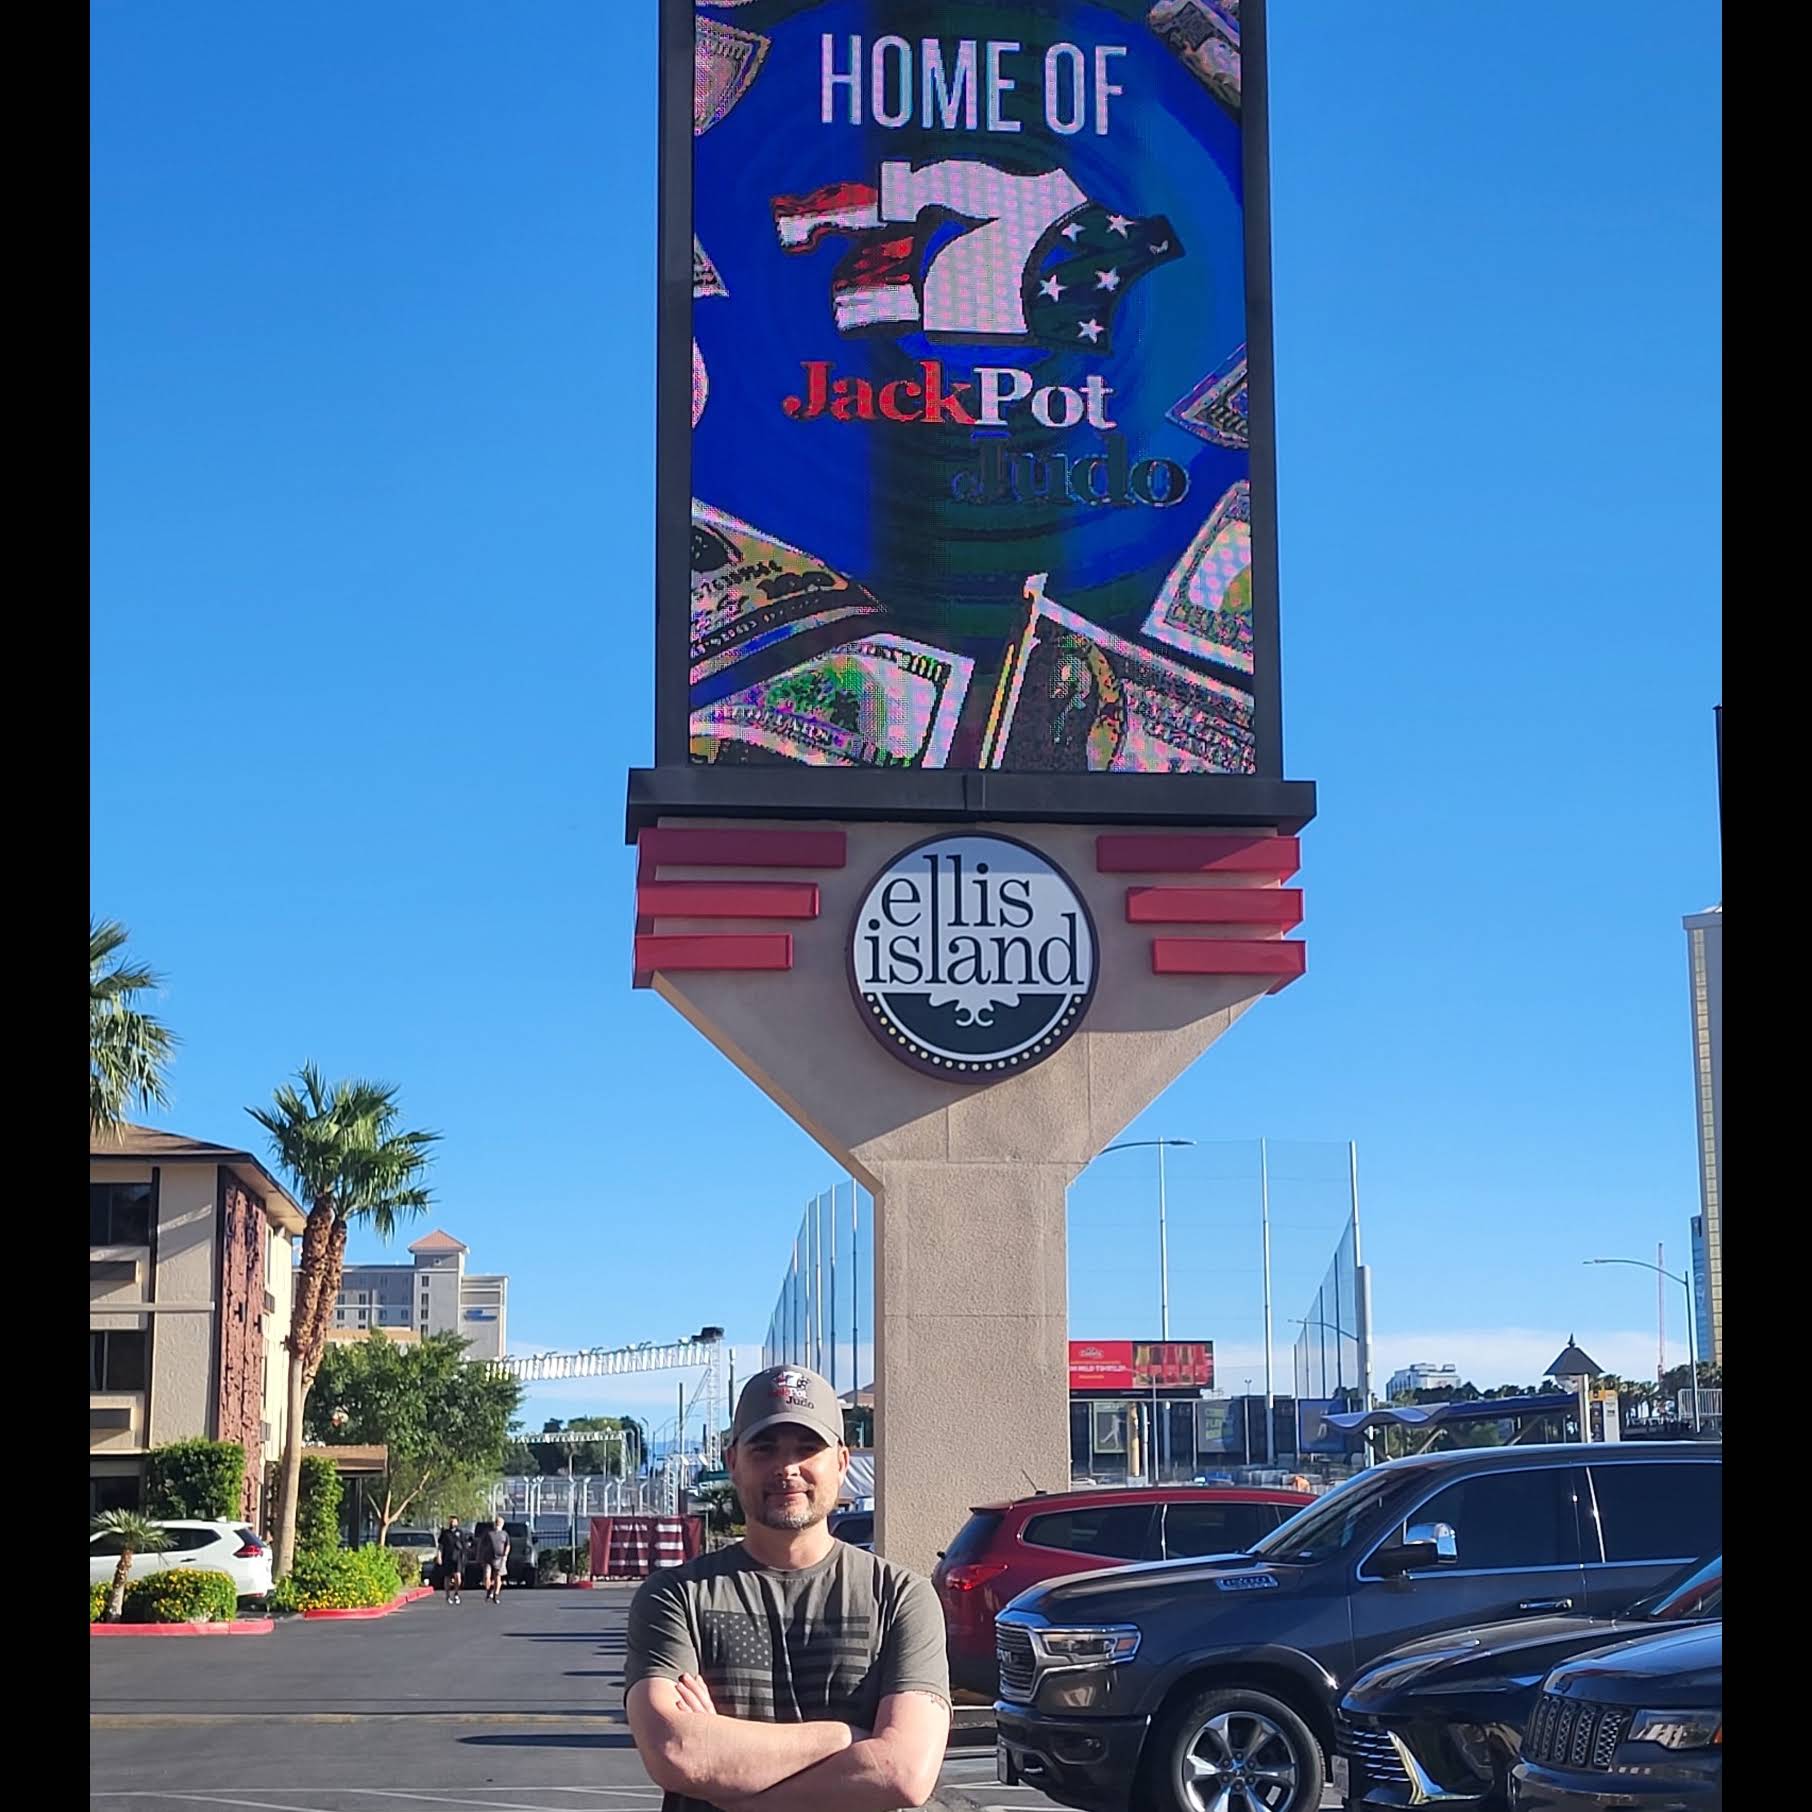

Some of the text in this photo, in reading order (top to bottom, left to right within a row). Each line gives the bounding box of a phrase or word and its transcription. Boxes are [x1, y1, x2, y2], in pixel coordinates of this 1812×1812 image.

[821, 34, 1128, 135] HOME OF
[783, 361, 1116, 429] JackPot
[951, 432, 1190, 507] Judo
[881, 854, 1034, 928] ellis
[864, 913, 1085, 986] island
[786, 1396, 814, 1409] Judo
